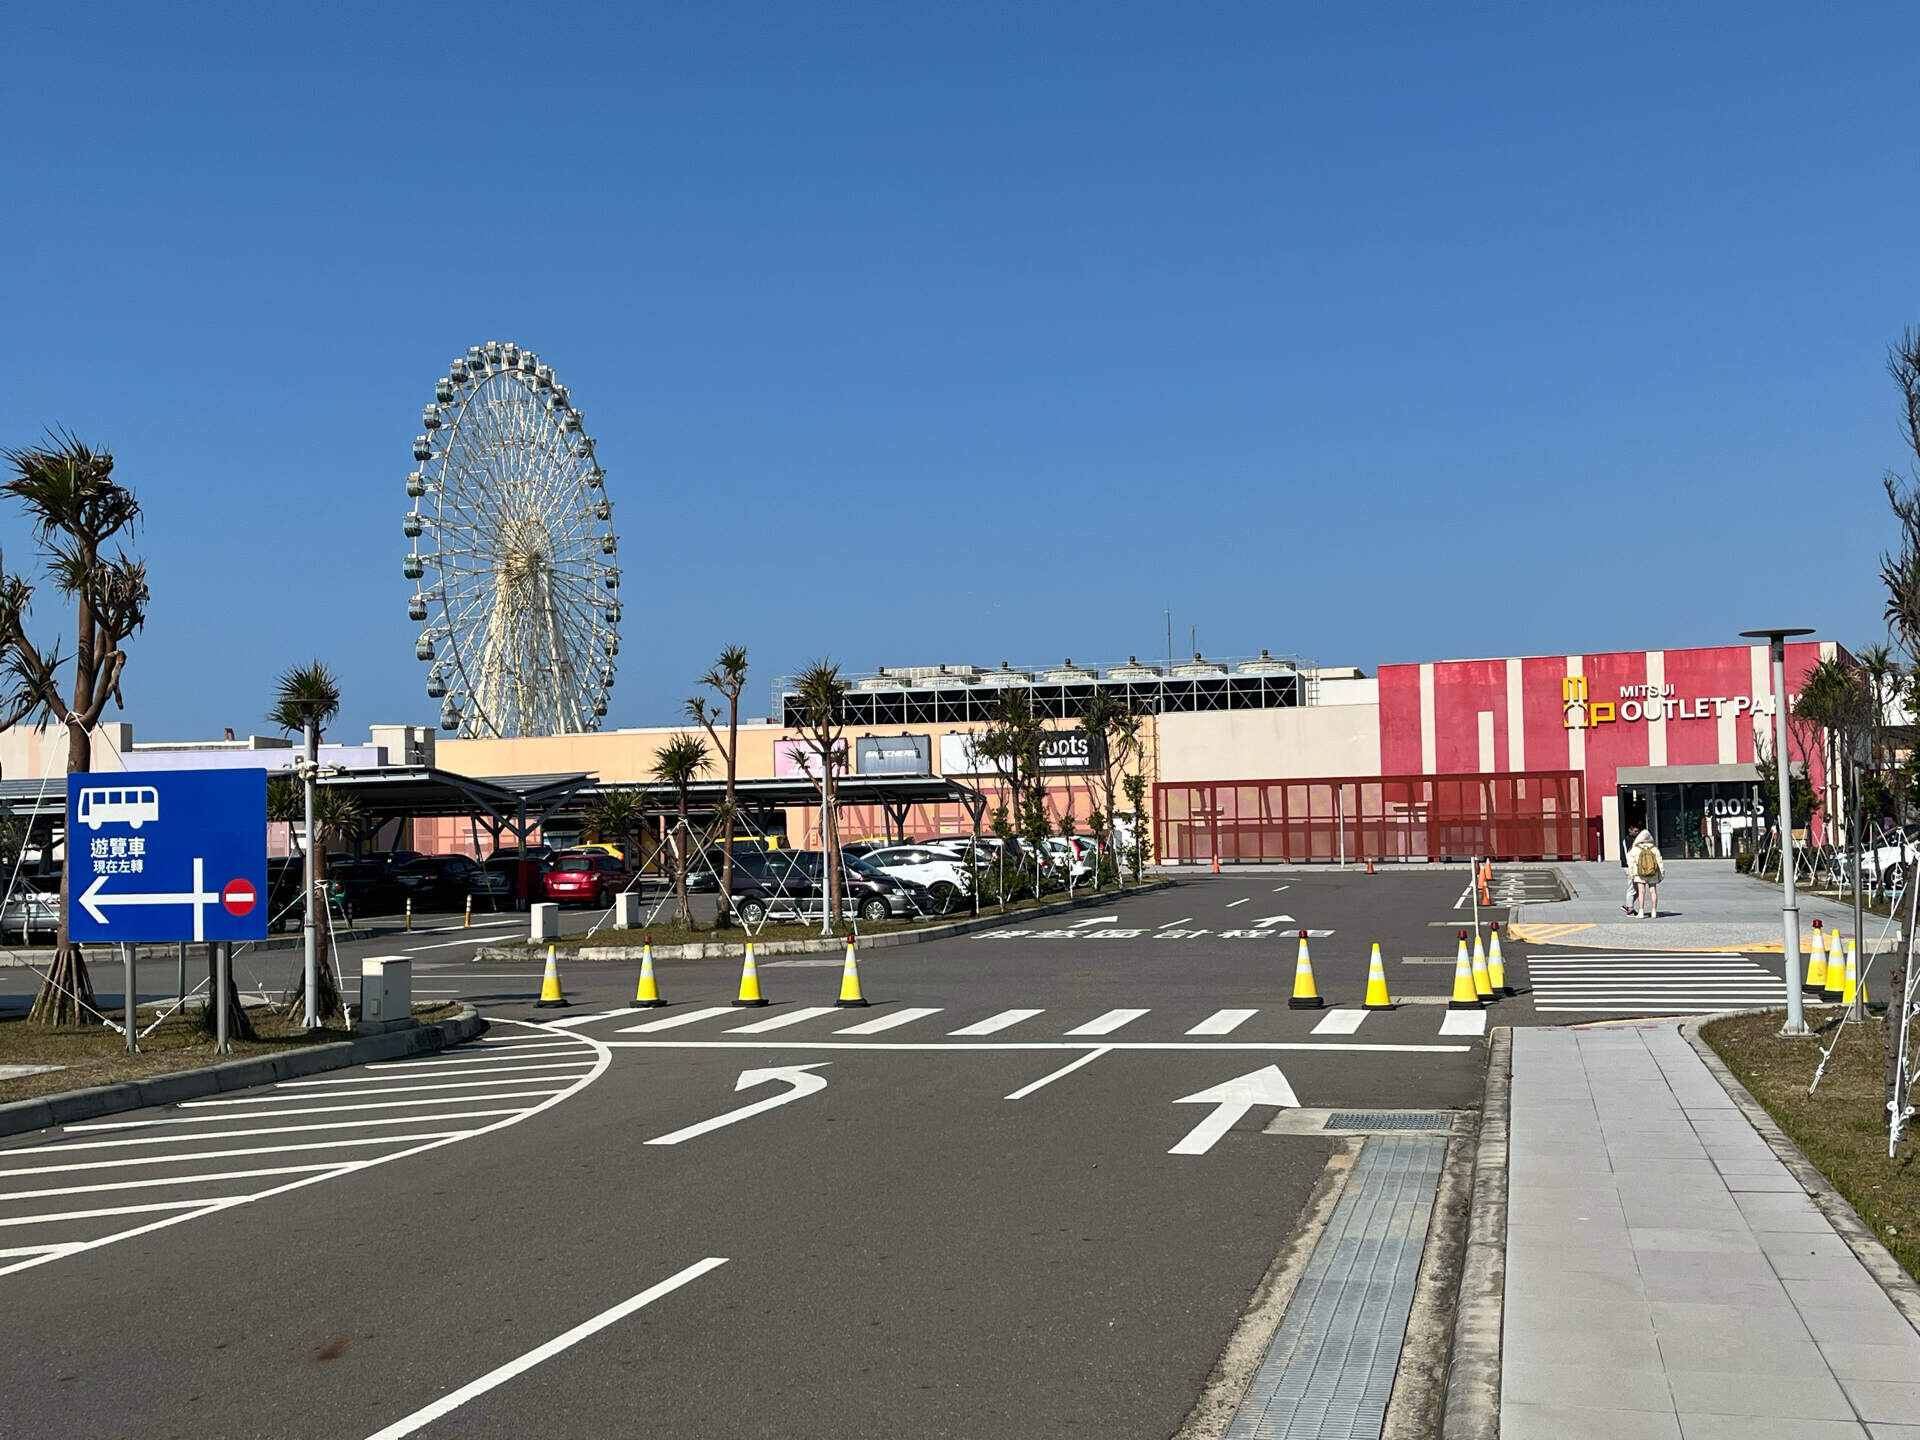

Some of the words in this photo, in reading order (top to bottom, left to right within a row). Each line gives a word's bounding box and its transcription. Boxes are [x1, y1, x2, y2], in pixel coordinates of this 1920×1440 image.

[1620, 684, 1675, 698] MITSUI
[1620, 697, 1727, 721] OUTLET
[1704, 798, 1765, 816] roots
[91, 837, 146, 858] 遊覽車
[93, 859, 144, 874] 現在左轉
